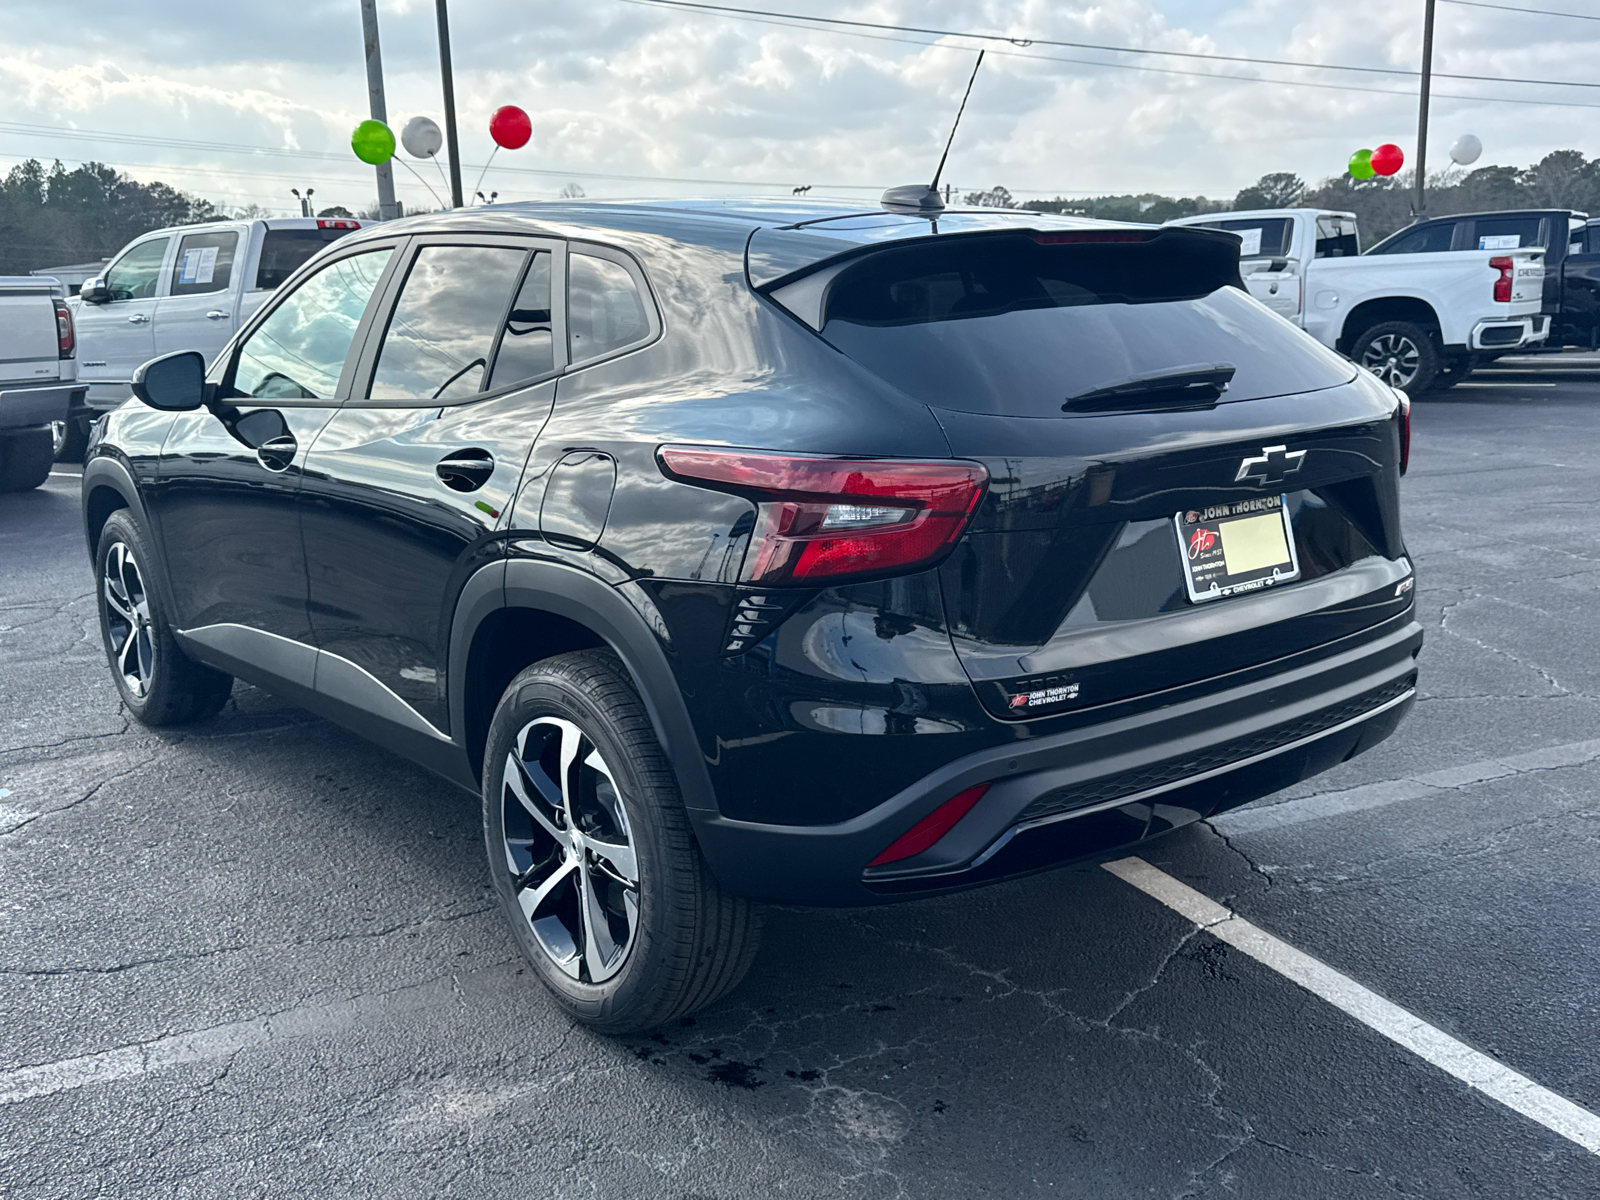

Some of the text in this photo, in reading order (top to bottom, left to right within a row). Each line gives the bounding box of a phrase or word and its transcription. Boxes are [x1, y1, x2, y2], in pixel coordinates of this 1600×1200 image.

[1203, 505, 1230, 520] JOHN
[1232, 496, 1281, 514] THORNTON
[1233, 580, 1265, 593] CHEVROLET
[1029, 684, 1079, 700] JOHN THORNTON
[1028, 694, 1067, 706] CHEVROLET
